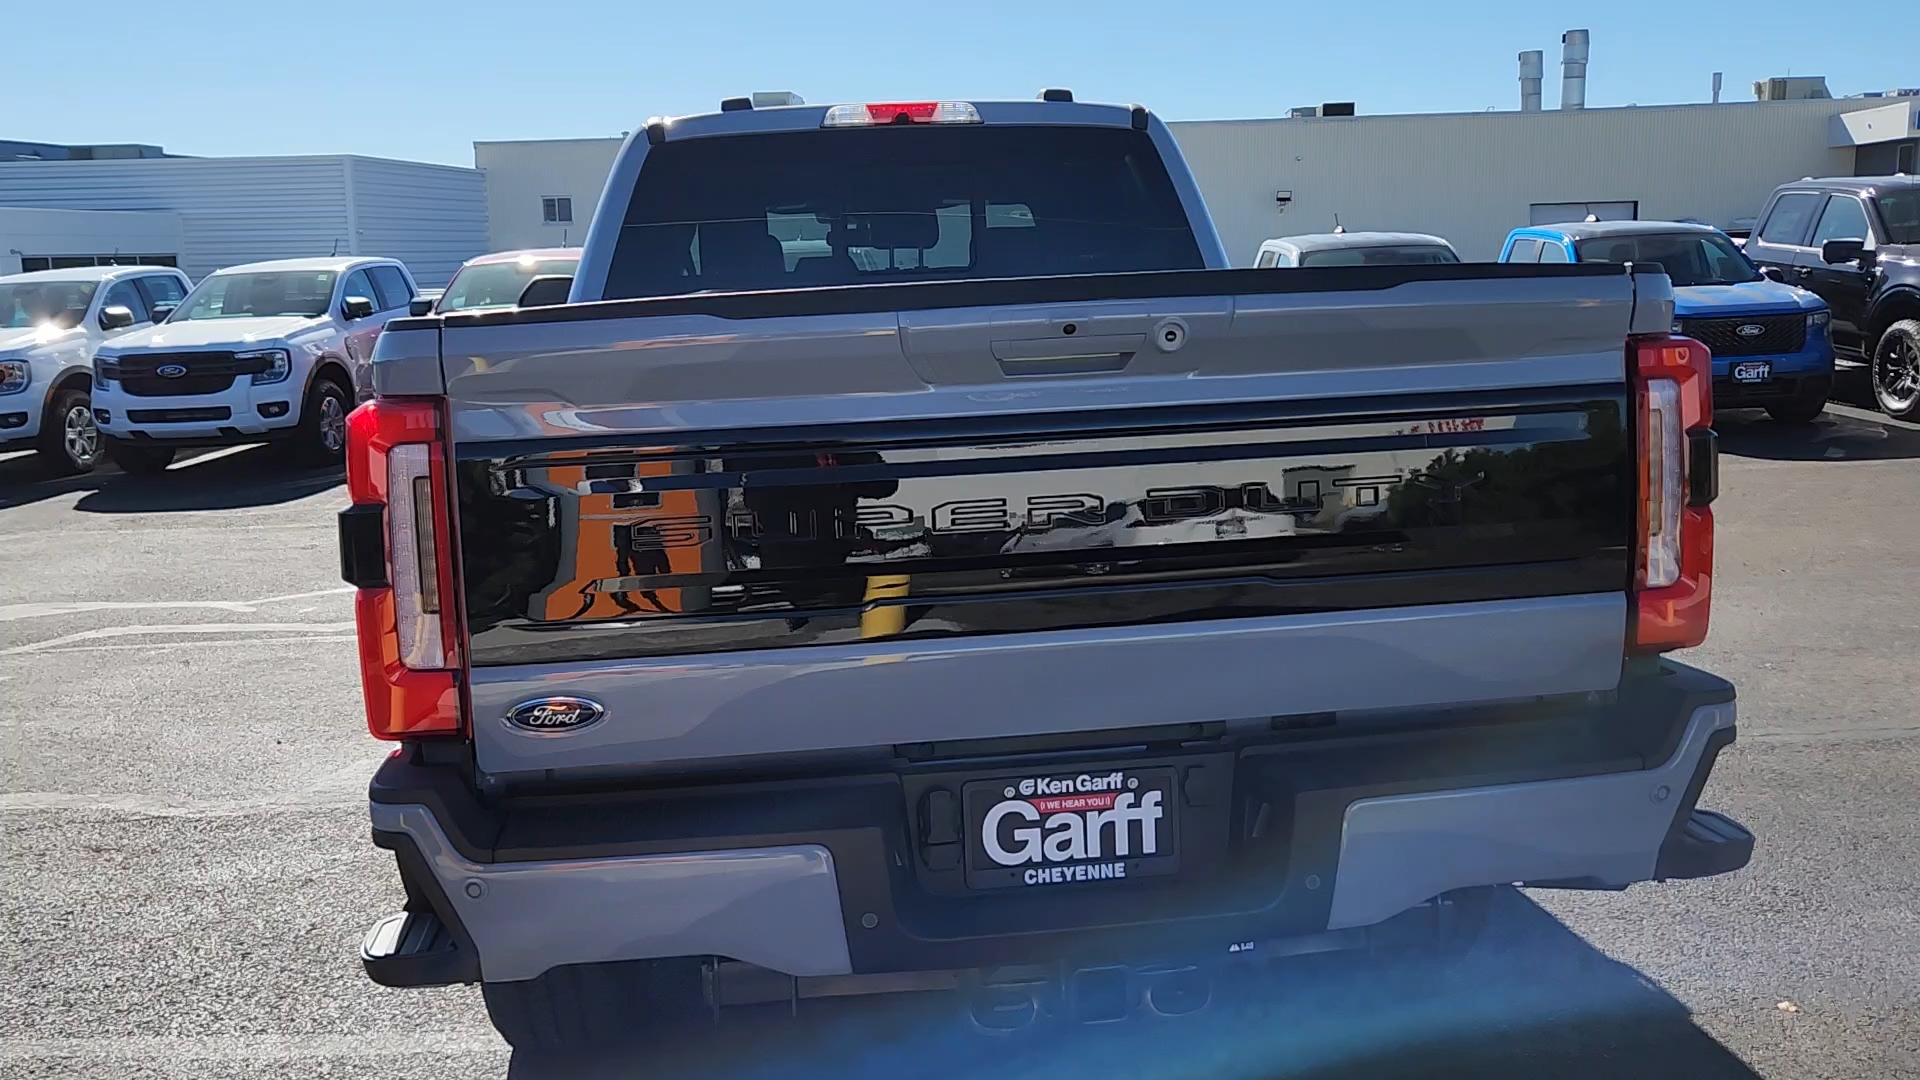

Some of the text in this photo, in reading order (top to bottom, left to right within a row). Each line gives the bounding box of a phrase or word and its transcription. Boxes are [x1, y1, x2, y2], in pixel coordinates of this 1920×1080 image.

[1735, 365, 1770, 379] Garff
[630, 493, 1105, 550] SUPER
[529, 704, 581, 725] Ford
[1036, 777, 1074, 795] Ken
[1076, 772, 1124, 791] Garff
[1046, 797, 1105, 810] WE HEAR YOU
[982, 790, 1163, 866] Garff
[1024, 862, 1126, 885] CHEYENNE
